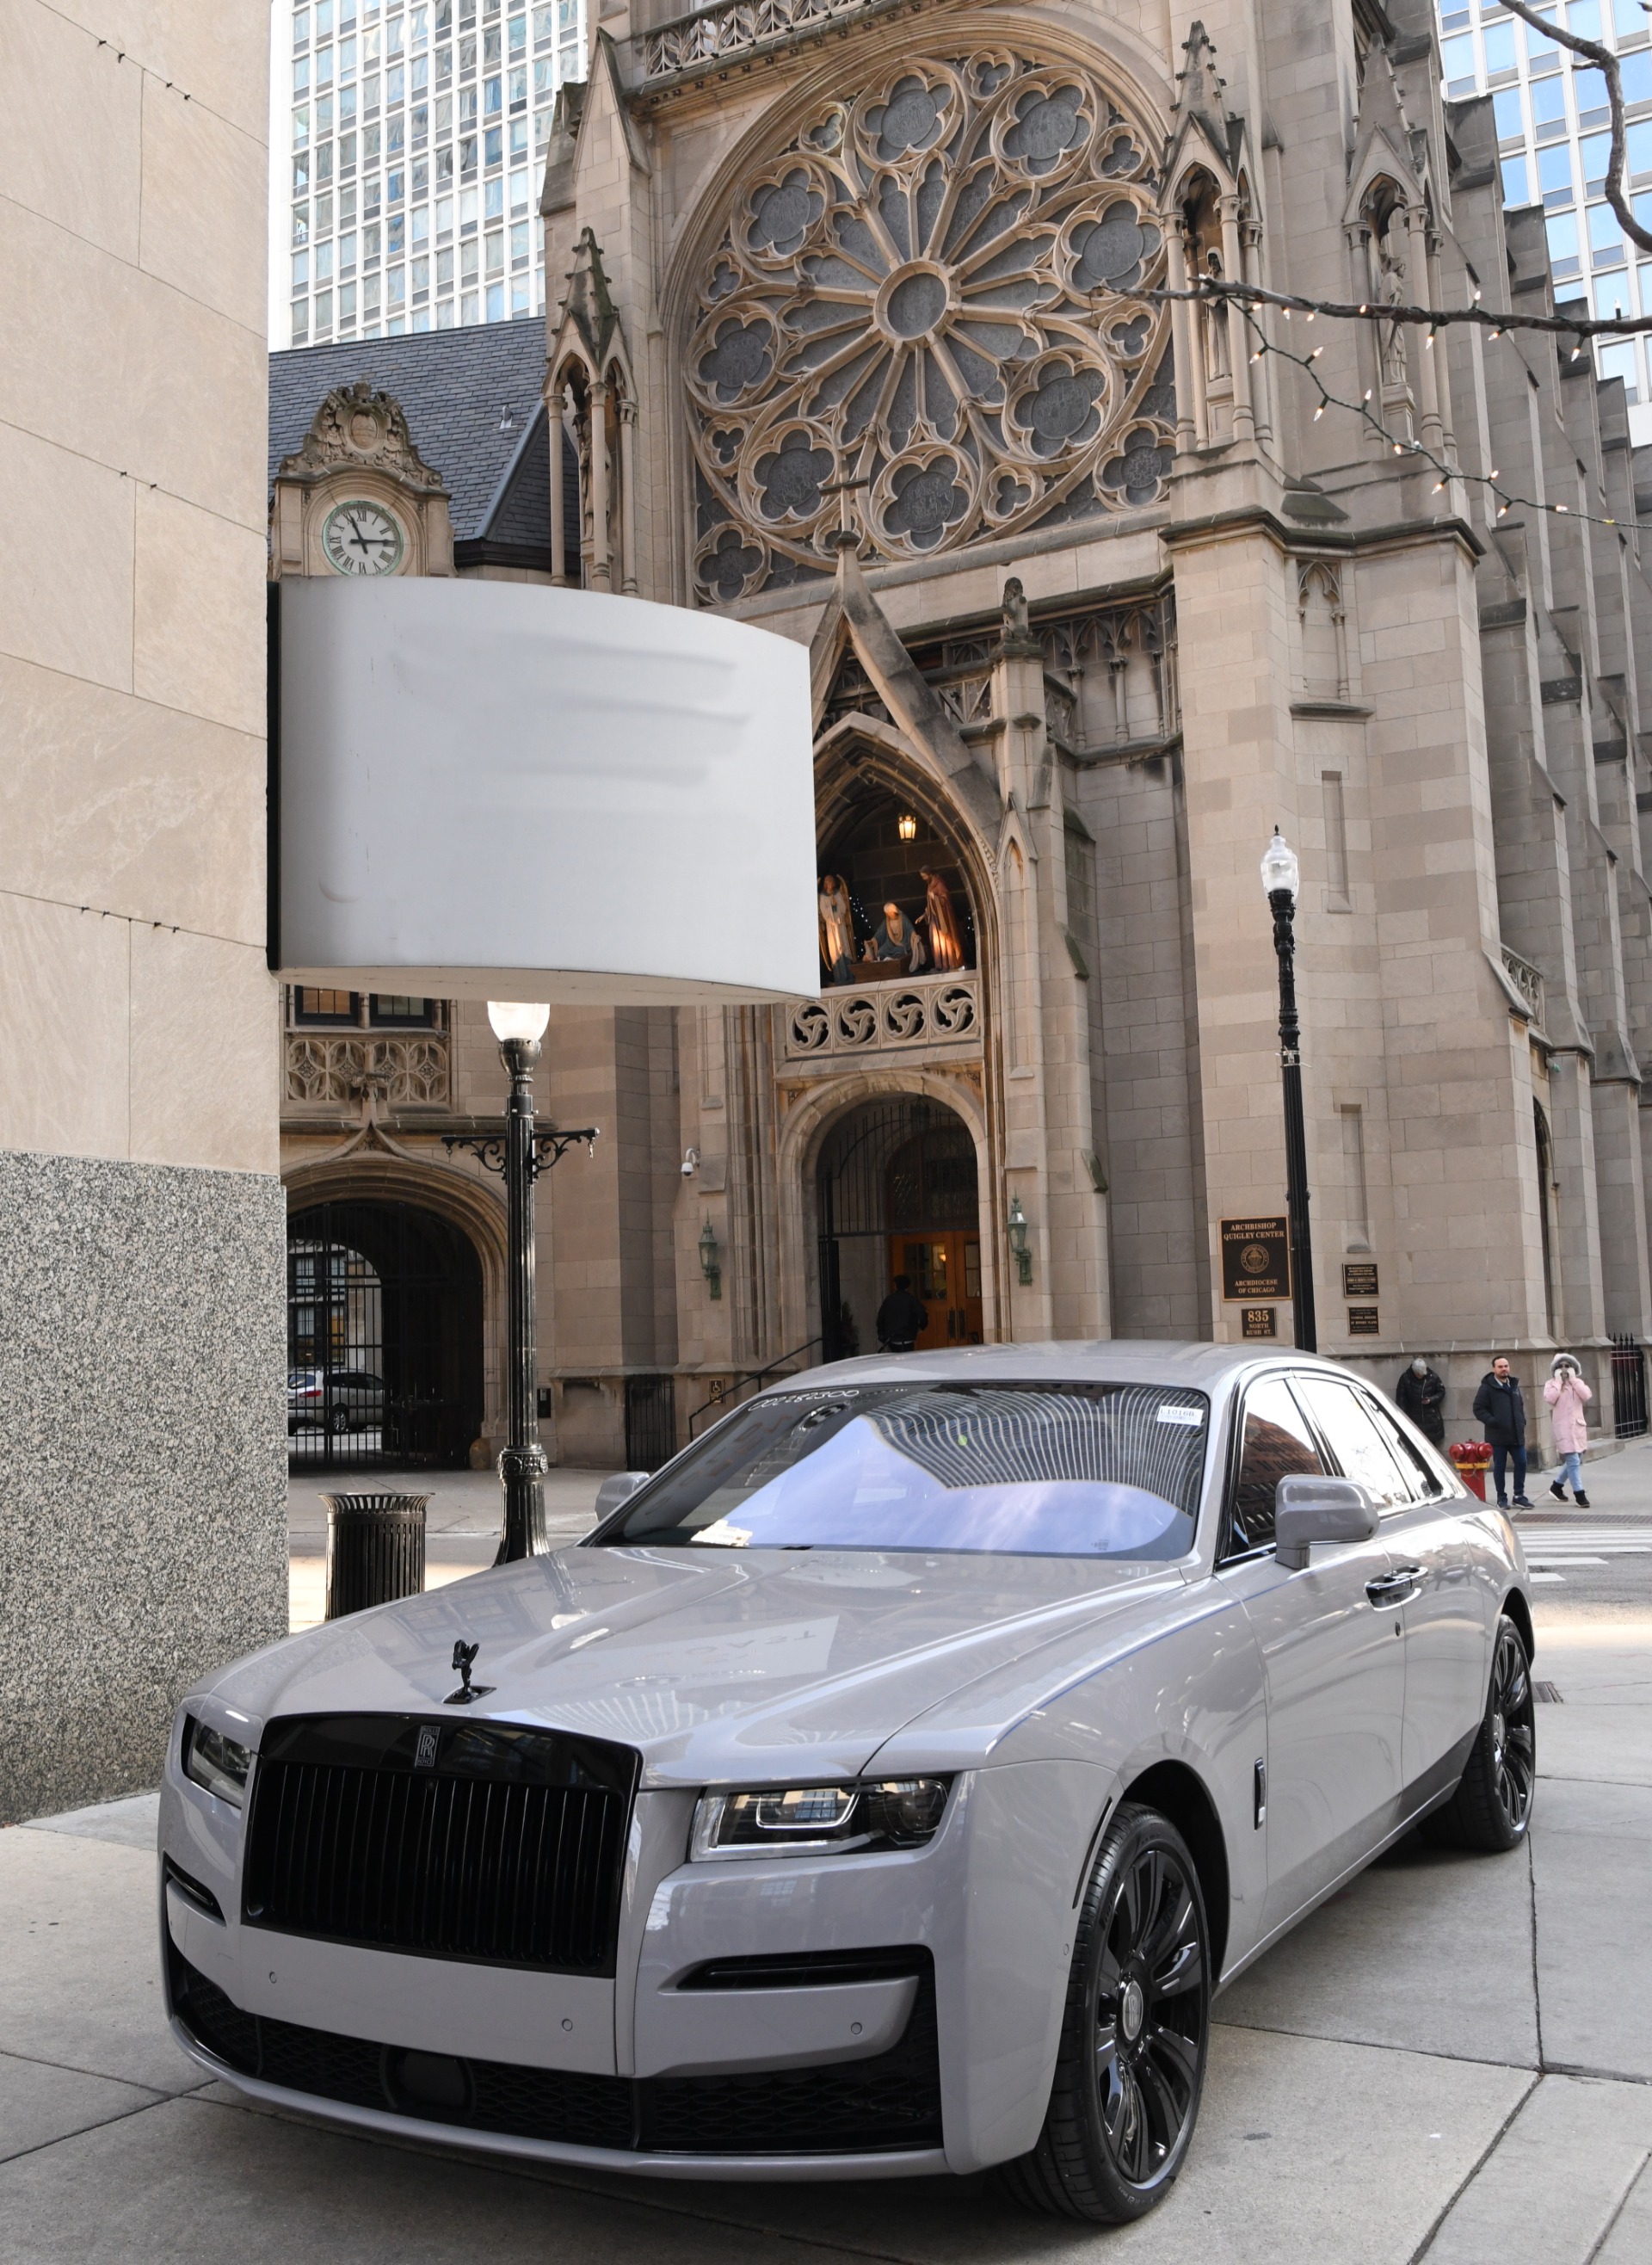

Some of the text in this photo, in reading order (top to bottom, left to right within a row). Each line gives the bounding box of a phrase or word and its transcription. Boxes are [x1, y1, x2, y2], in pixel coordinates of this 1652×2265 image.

[1230, 1222, 1277, 1231] ARCHBISHOP
[1224, 1231, 1254, 1241] QUIGLEY
[1248, 1310, 1269, 1323] 835
